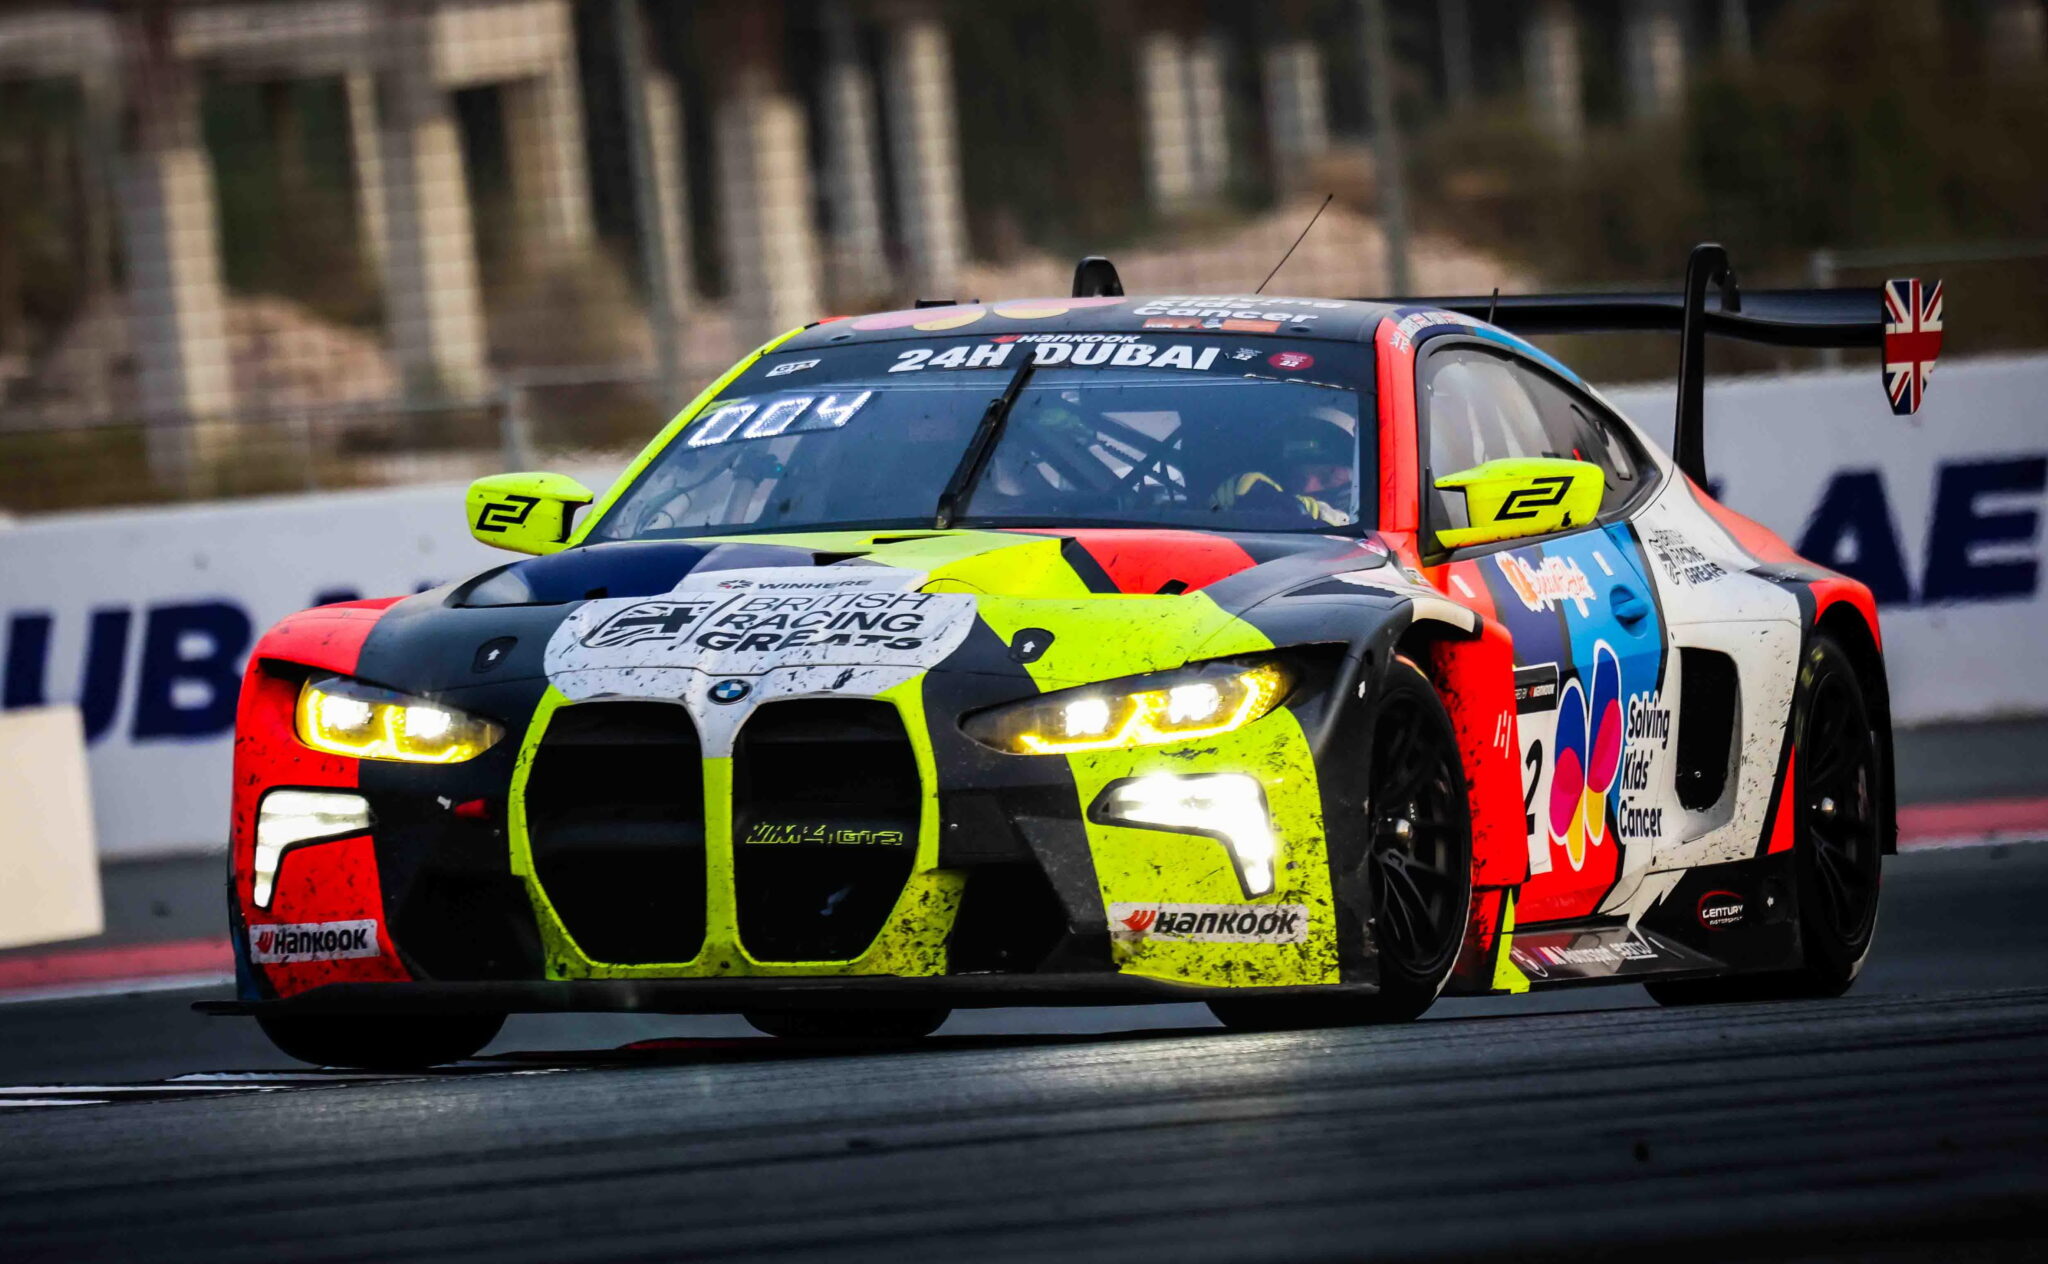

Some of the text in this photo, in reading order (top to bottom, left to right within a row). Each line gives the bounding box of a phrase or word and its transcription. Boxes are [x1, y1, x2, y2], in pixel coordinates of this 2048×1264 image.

[1133, 305, 1319, 323] Cancer
[888, 343, 1221, 373] 24H DUBAI
[1708, 455, 2048, 608] AE
[758, 580, 872, 590] WINHERE
[1684, 562, 1728, 585] GREATS
[738, 593, 935, 611] BRITISH
[714, 611, 925, 632] RACING
[697, 629, 928, 652] GREATS
[1628, 698, 1670, 750] Solving
[1619, 802, 1662, 838] Cancer
[1702, 904, 1744, 919] CENTURY
